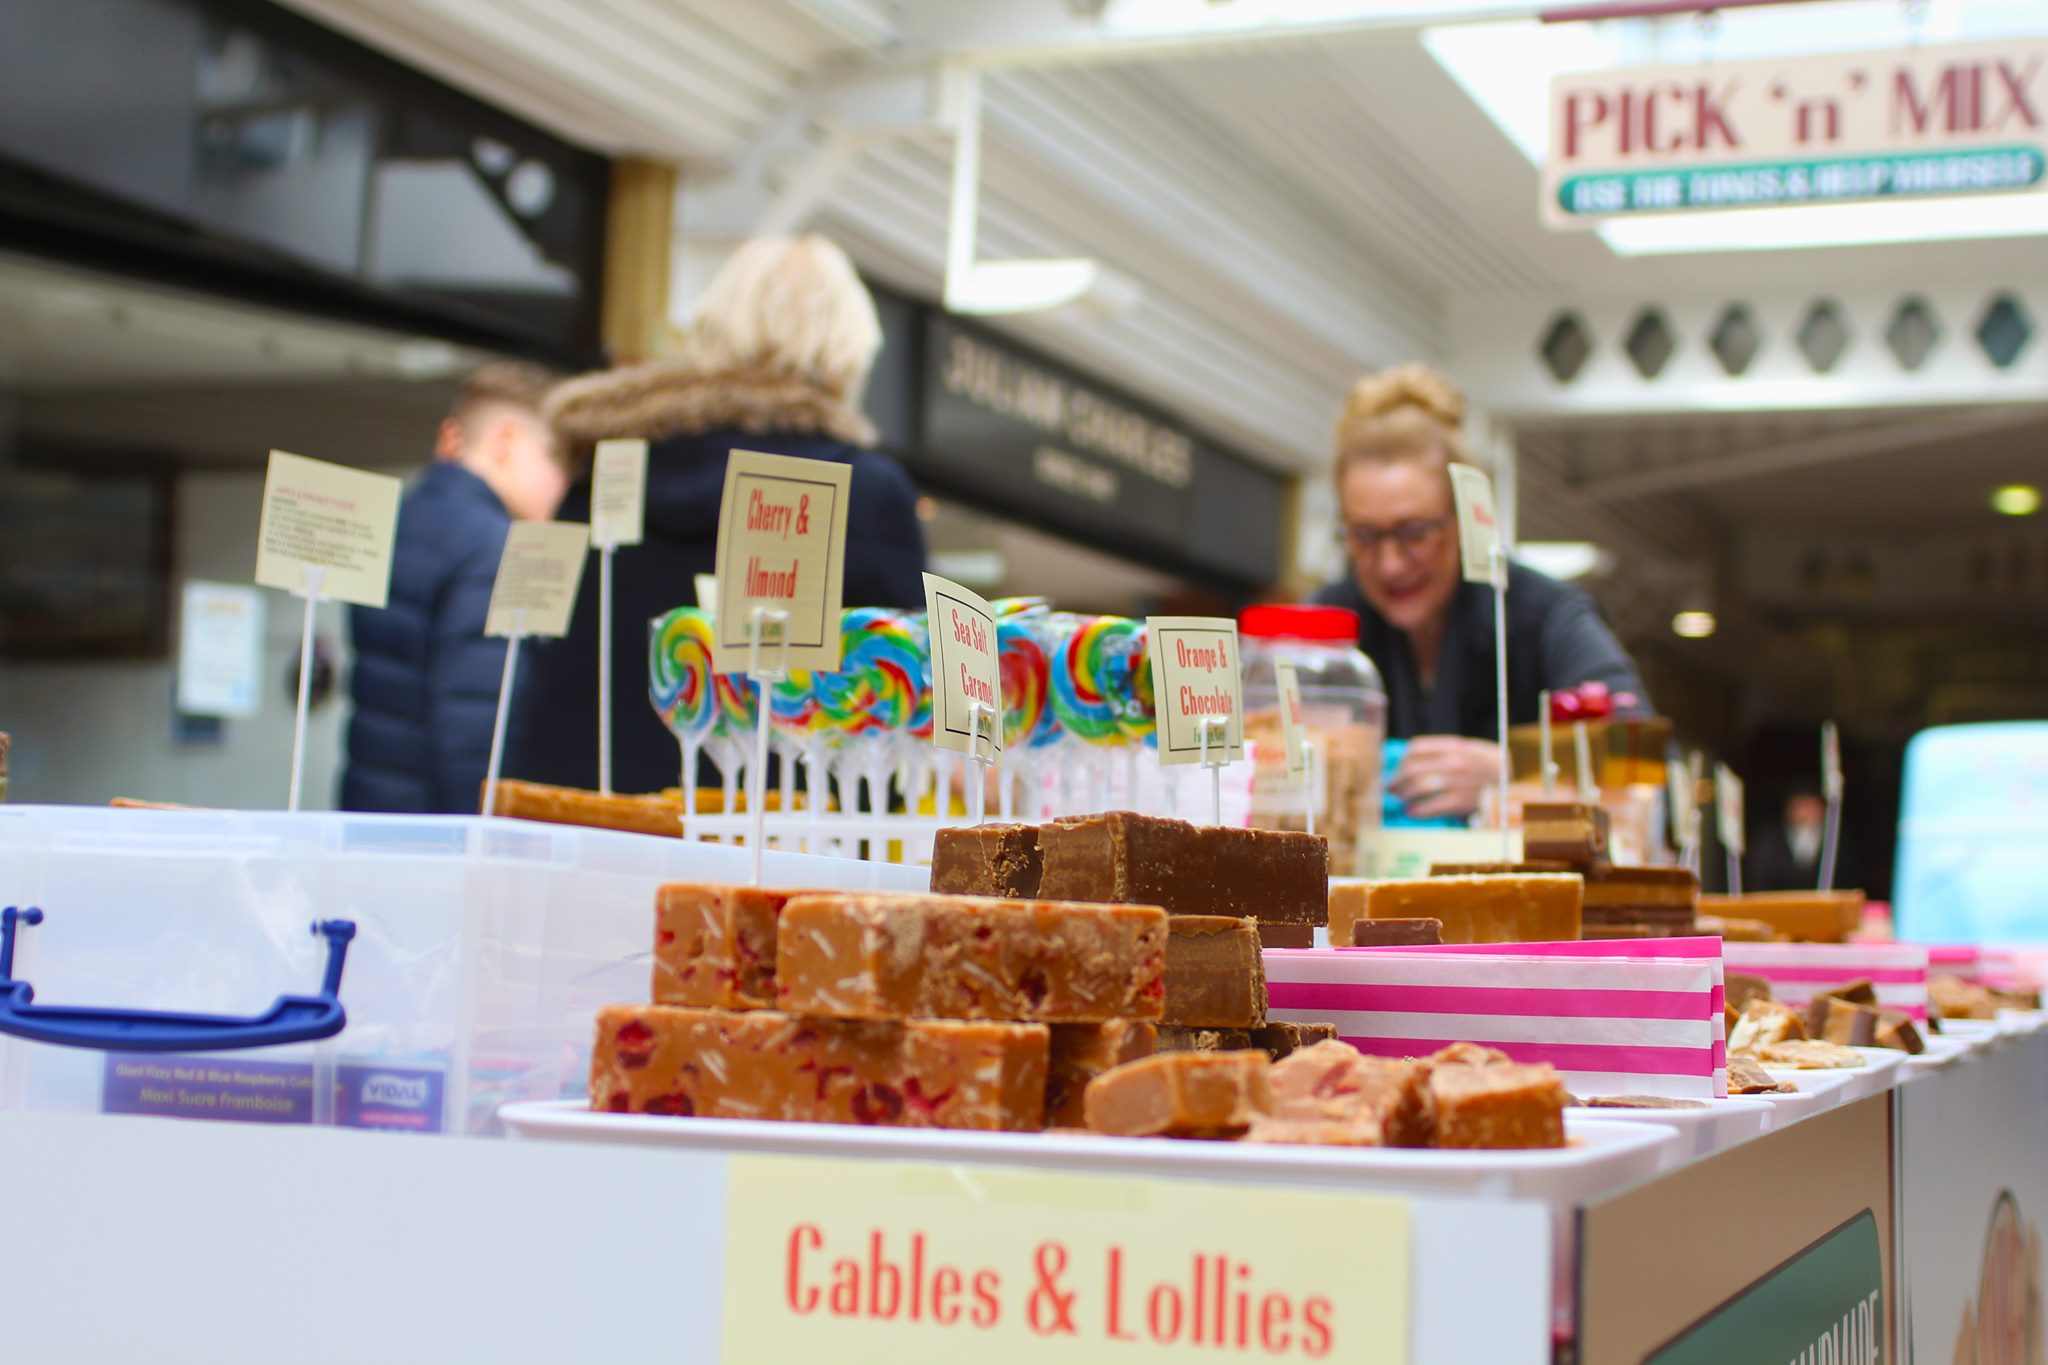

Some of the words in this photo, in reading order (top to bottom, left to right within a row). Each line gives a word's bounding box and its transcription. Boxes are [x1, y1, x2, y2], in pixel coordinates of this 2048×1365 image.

[1563, 77, 1741, 160] PICK
[1890, 52, 2044, 136] MIX
[746, 487, 792, 541] Cherry
[795, 493, 810, 535] &
[744, 556, 798, 599] Almond
[951, 608, 971, 647] Sea
[971, 617, 989, 656] Salt
[1176, 638, 1217, 673] Orange
[1217, 640, 1228, 668] &
[116, 1063, 144, 1078] Giant
[146, 1065, 171, 1081] Fizzy
[174, 1067, 194, 1081] Red
[208, 1068, 231, 1083] Blue
[233, 1071, 288, 1088] Raspberry
[368, 1081, 423, 1102] VIDAL
[141, 1088, 174, 1102] Maxi
[177, 1089, 215, 1107] Sucre
[219, 1092, 295, 1113] Framboise
[785, 1221, 1003, 1330] Cables
[1024, 1239, 1081, 1338] &
[1104, 1244, 1336, 1360] Lollies
